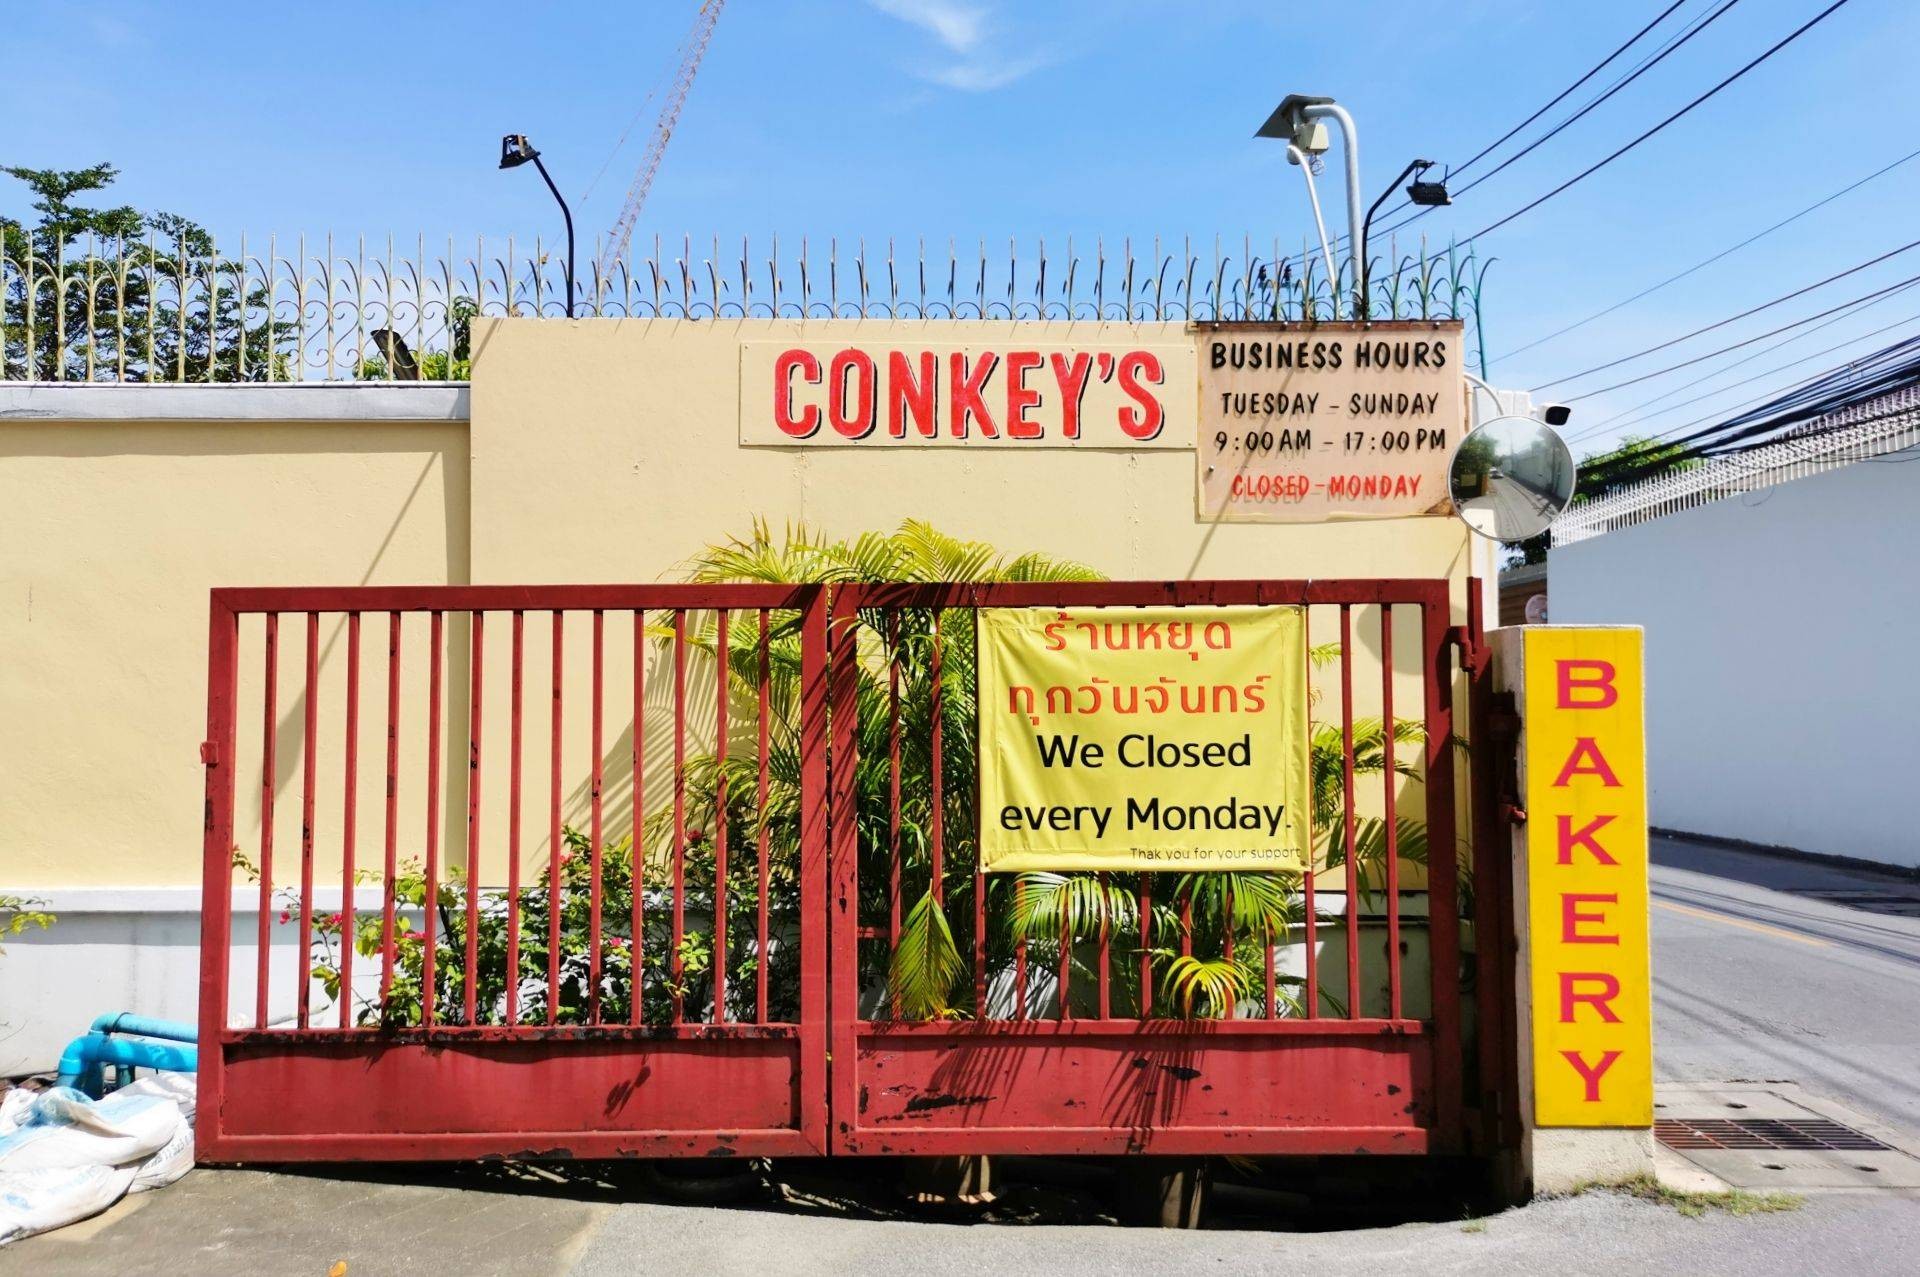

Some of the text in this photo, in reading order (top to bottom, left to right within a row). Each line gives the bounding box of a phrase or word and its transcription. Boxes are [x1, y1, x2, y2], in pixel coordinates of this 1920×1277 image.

[1211, 341, 1446, 369] BUSINESS HOURS
[774, 348, 1164, 440] CONKEY'S
[1221, 391, 1319, 415] TUESDAY
[1349, 392, 1439, 415] SUNDAY
[1044, 611, 1232, 661] ร้านหยุด
[1009, 676, 1271, 726] ทุกวันจันทร์
[1036, 733, 1251, 768] We Closed
[1000, 797, 1292, 838] every Monday.
[1130, 848, 1161, 860] Thak
[1165, 849, 1190, 861] you
[1194, 847, 1213, 860] for
[1217, 849, 1246, 861] your
[1551, 659, 1624, 1103] BAKERY
